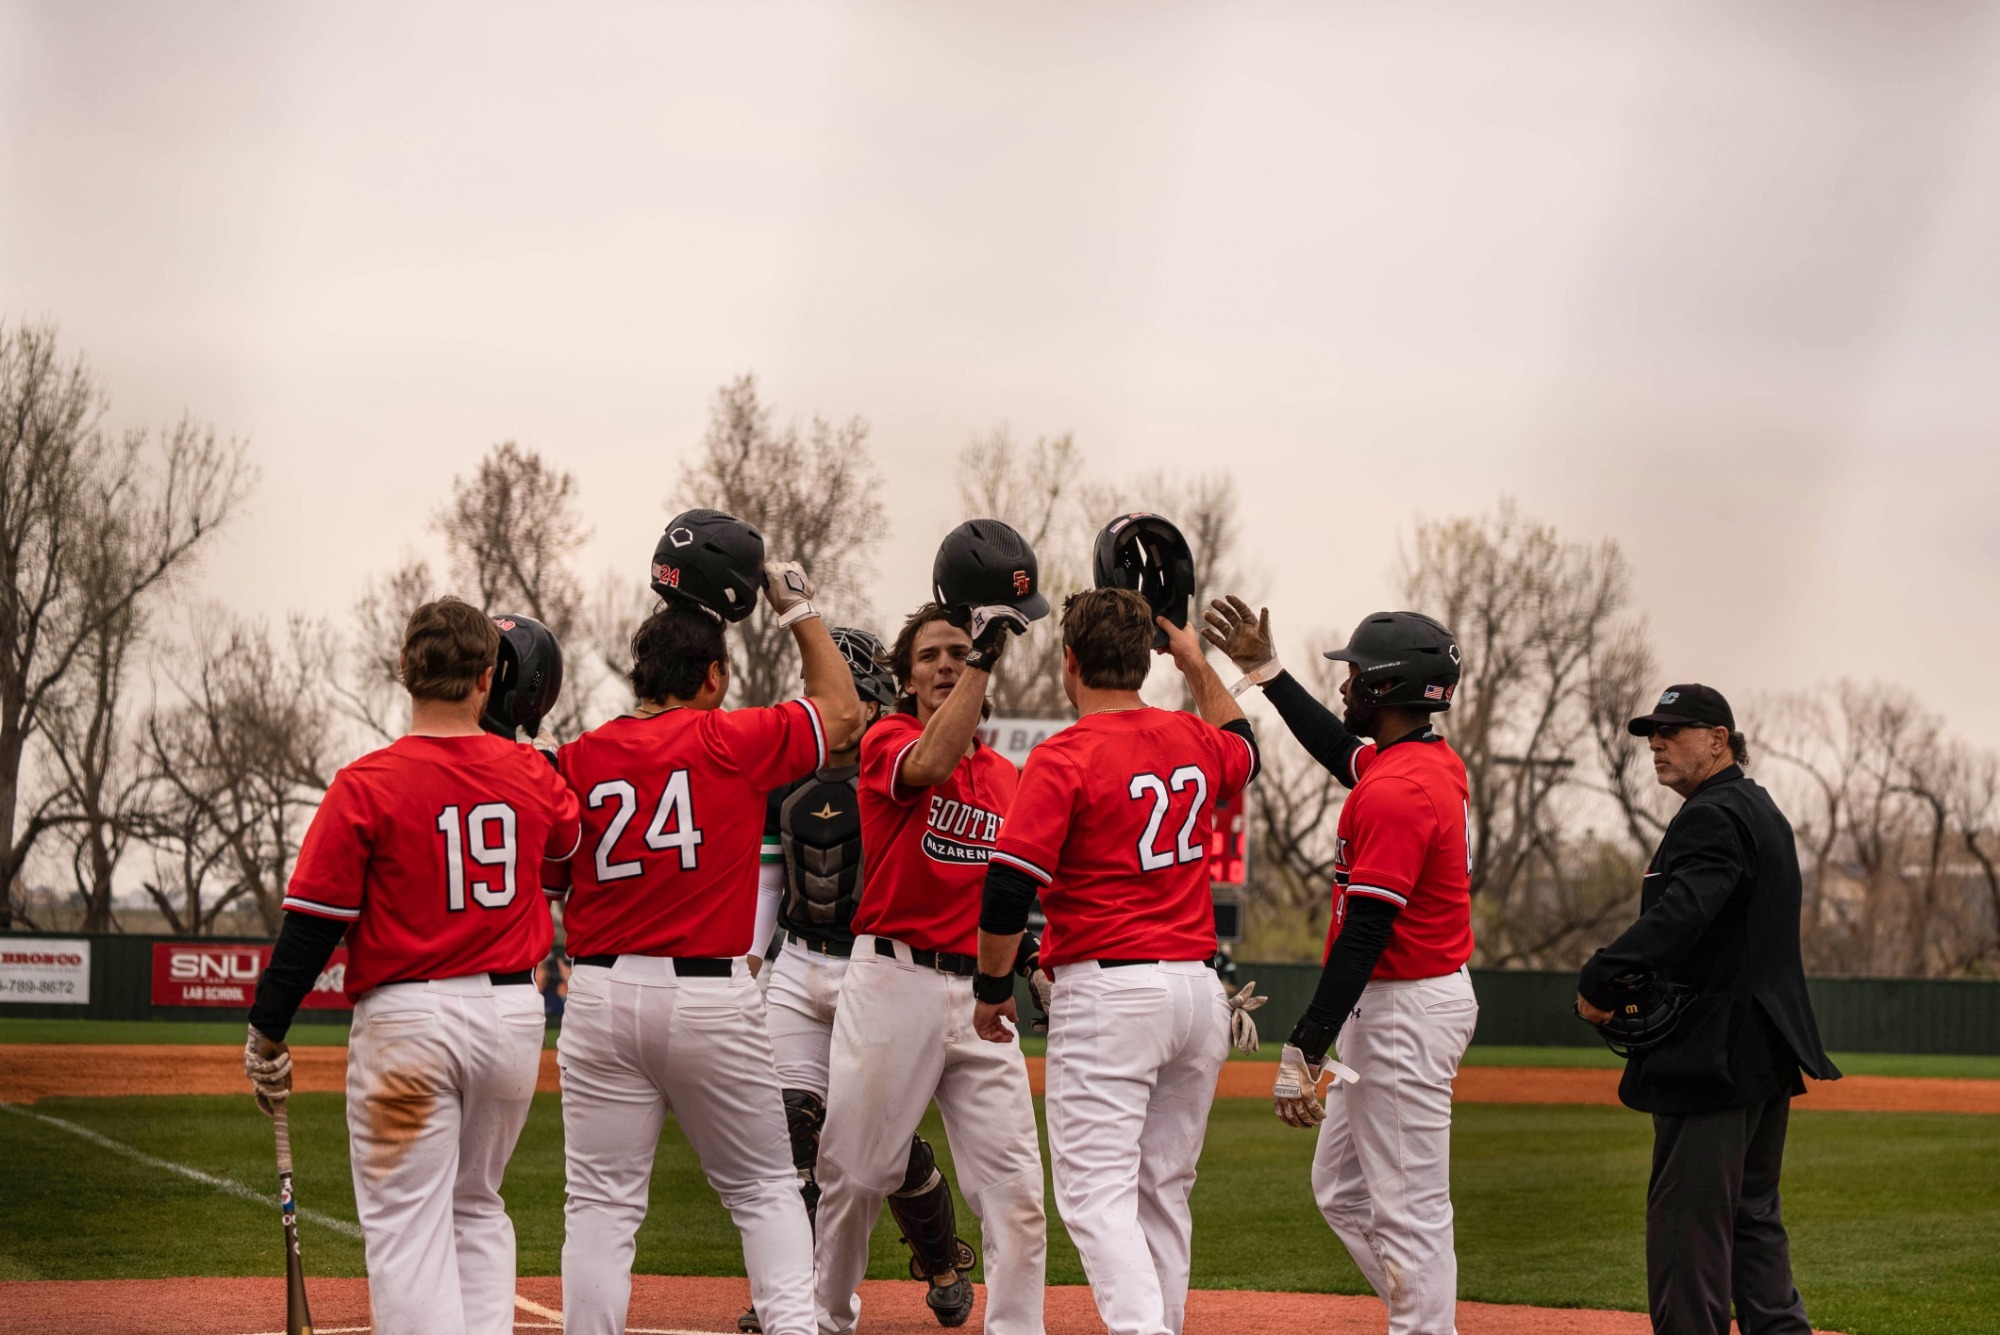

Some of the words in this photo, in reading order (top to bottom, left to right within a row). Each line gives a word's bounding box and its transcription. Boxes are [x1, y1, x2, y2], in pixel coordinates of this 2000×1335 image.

[660, 565, 680, 588] 24
[588, 768, 704, 884] 24
[1128, 764, 1208, 873] 22
[436, 802, 518, 913] 19
[2, 951, 82, 967] BRONCO
[170, 954, 260, 979] SNU
[183, 986, 203, 1000] LAB
[205, 986, 245, 1001] SCHOOL
